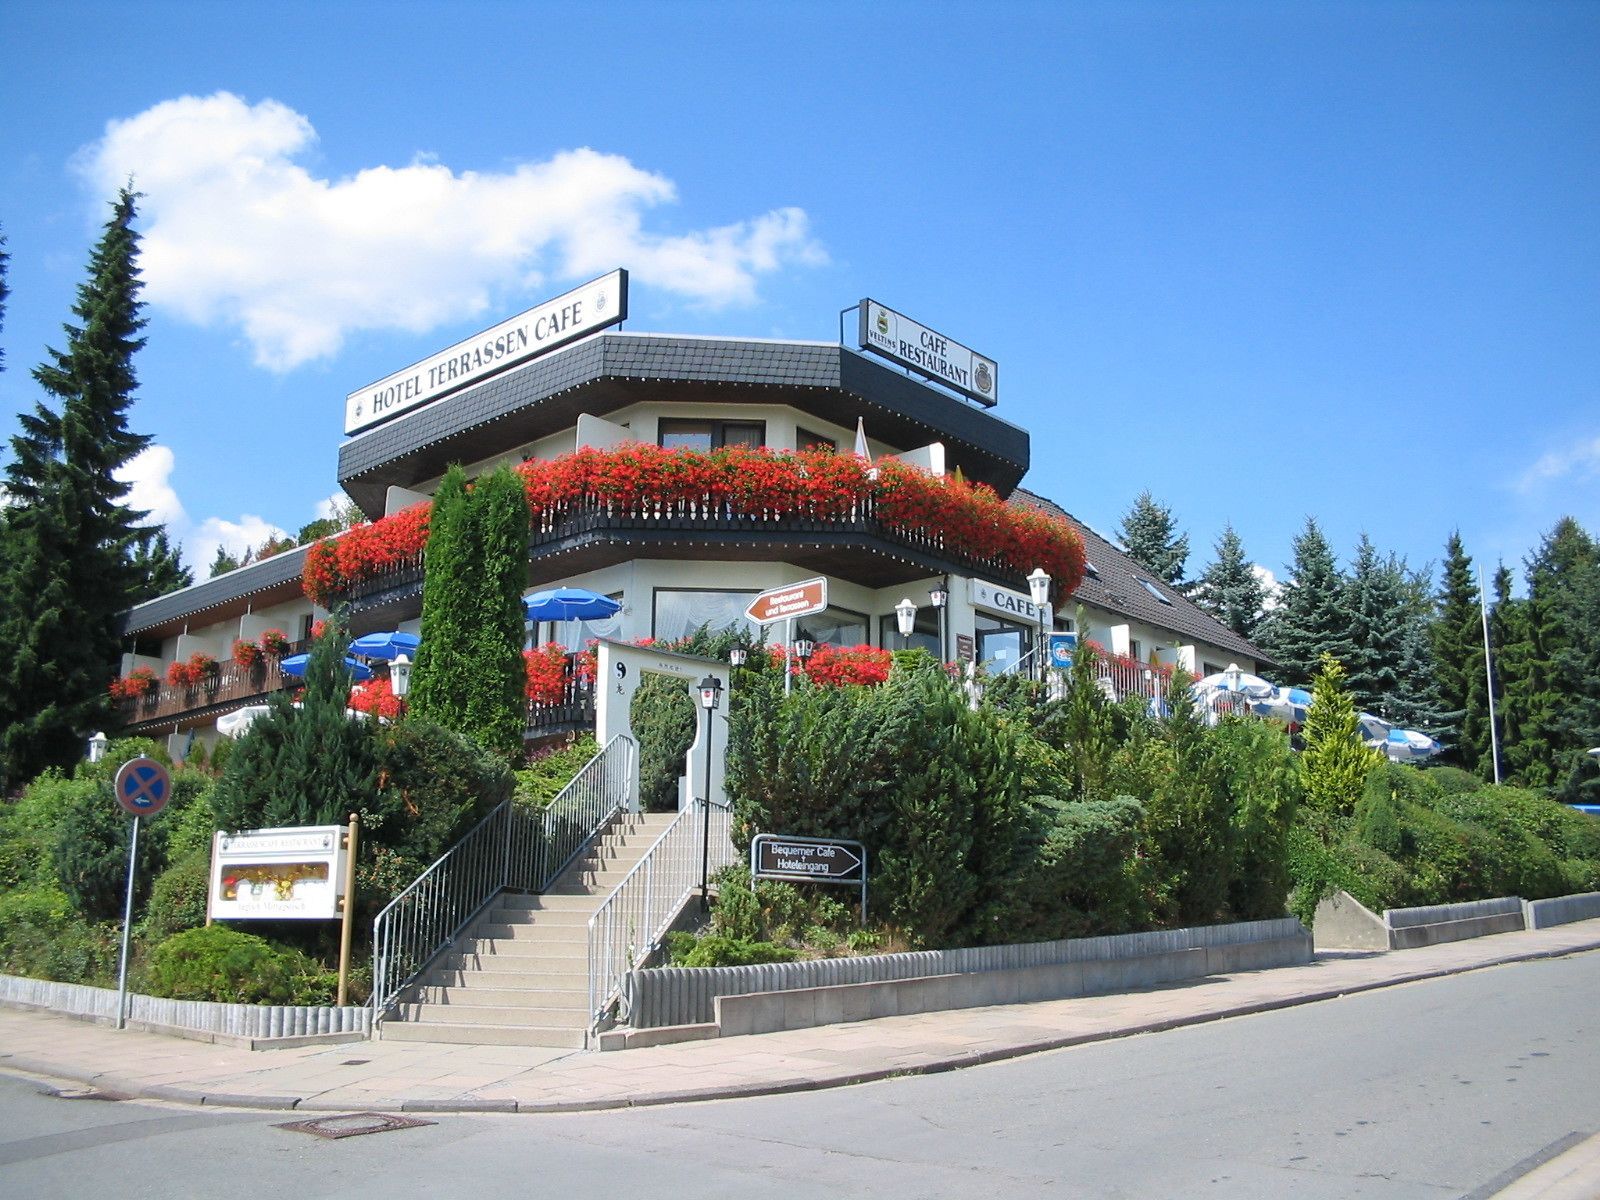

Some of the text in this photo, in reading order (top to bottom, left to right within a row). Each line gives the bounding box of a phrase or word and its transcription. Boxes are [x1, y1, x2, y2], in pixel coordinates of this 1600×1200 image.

[869, 329, 896, 348] VELTINS
[373, 300, 583, 414] HOTEL TERRASSEN CAFE
[899, 339, 968, 386] RESTAURANT
[993, 591, 1035, 617] CAFE
[771, 843, 816, 857] Bequemer
[777, 858, 829, 874] Hoteleingang
